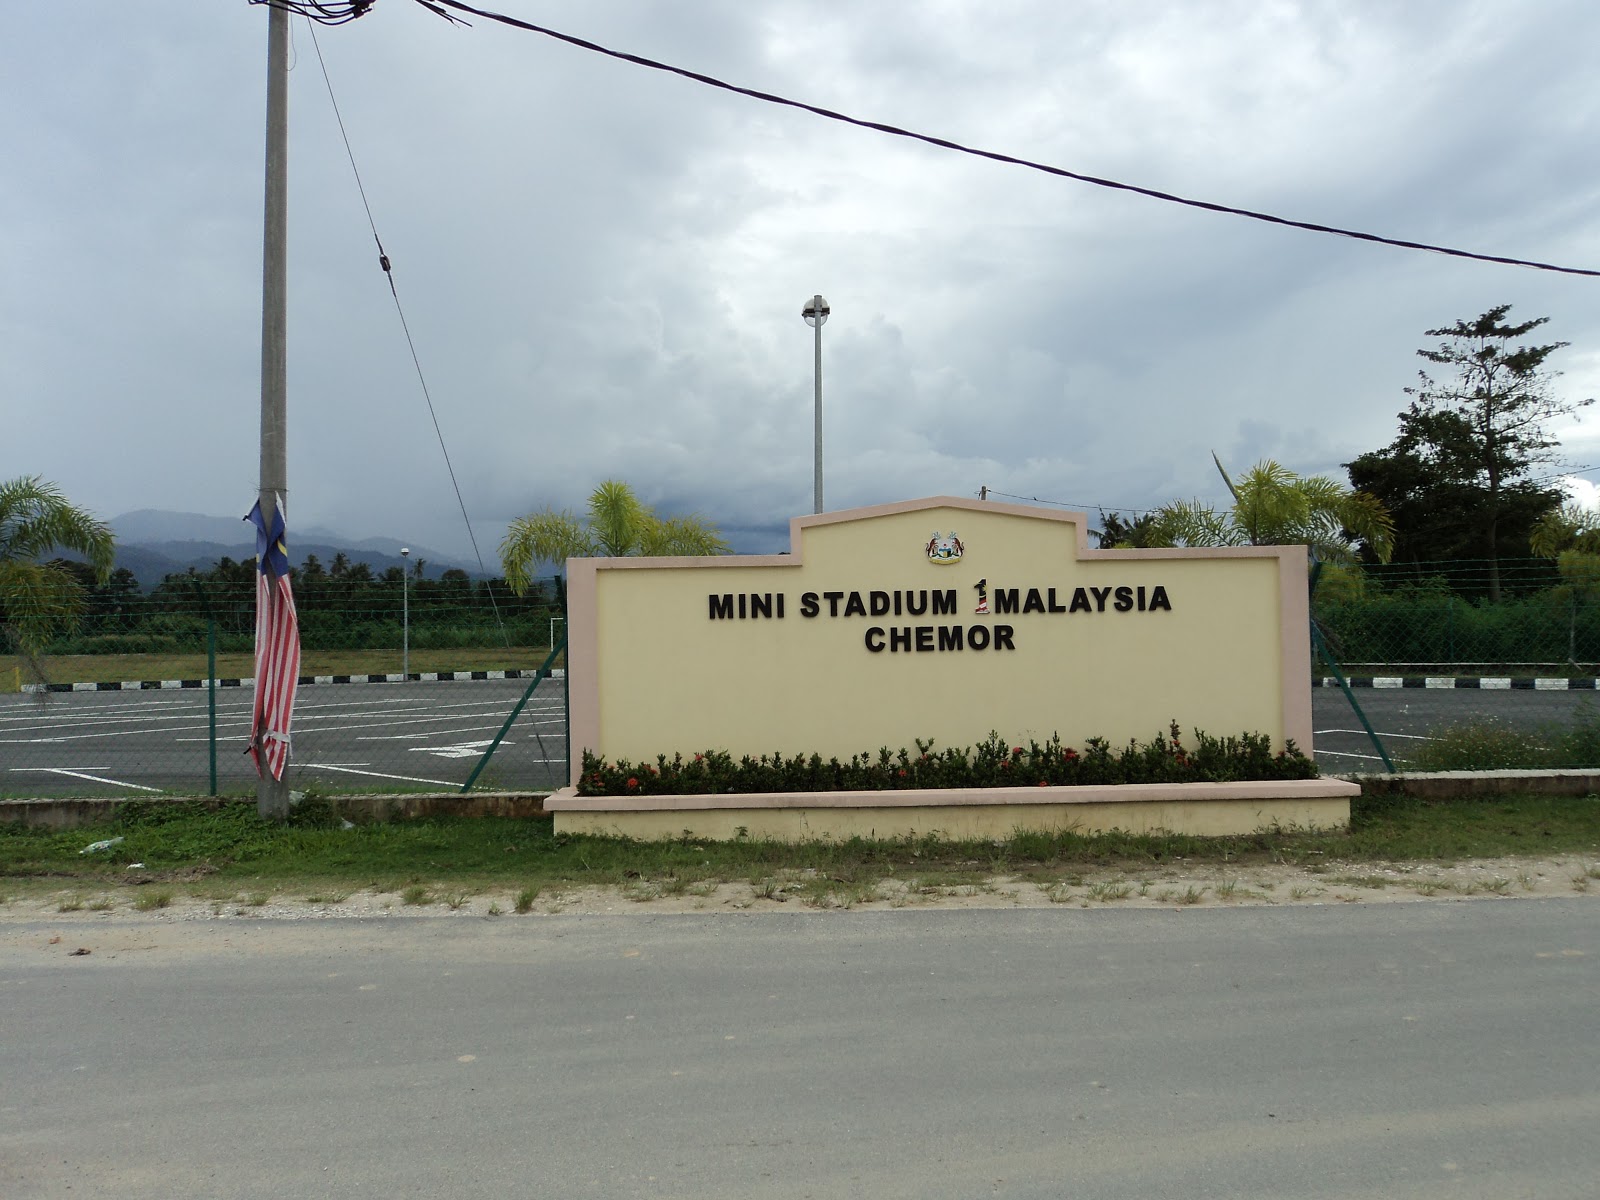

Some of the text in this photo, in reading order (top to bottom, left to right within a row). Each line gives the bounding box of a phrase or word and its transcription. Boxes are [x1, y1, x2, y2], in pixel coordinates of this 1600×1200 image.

[708, 592, 785, 621] MINI
[799, 589, 957, 619] STADIUM
[864, 624, 1016, 654] CHEMOR
